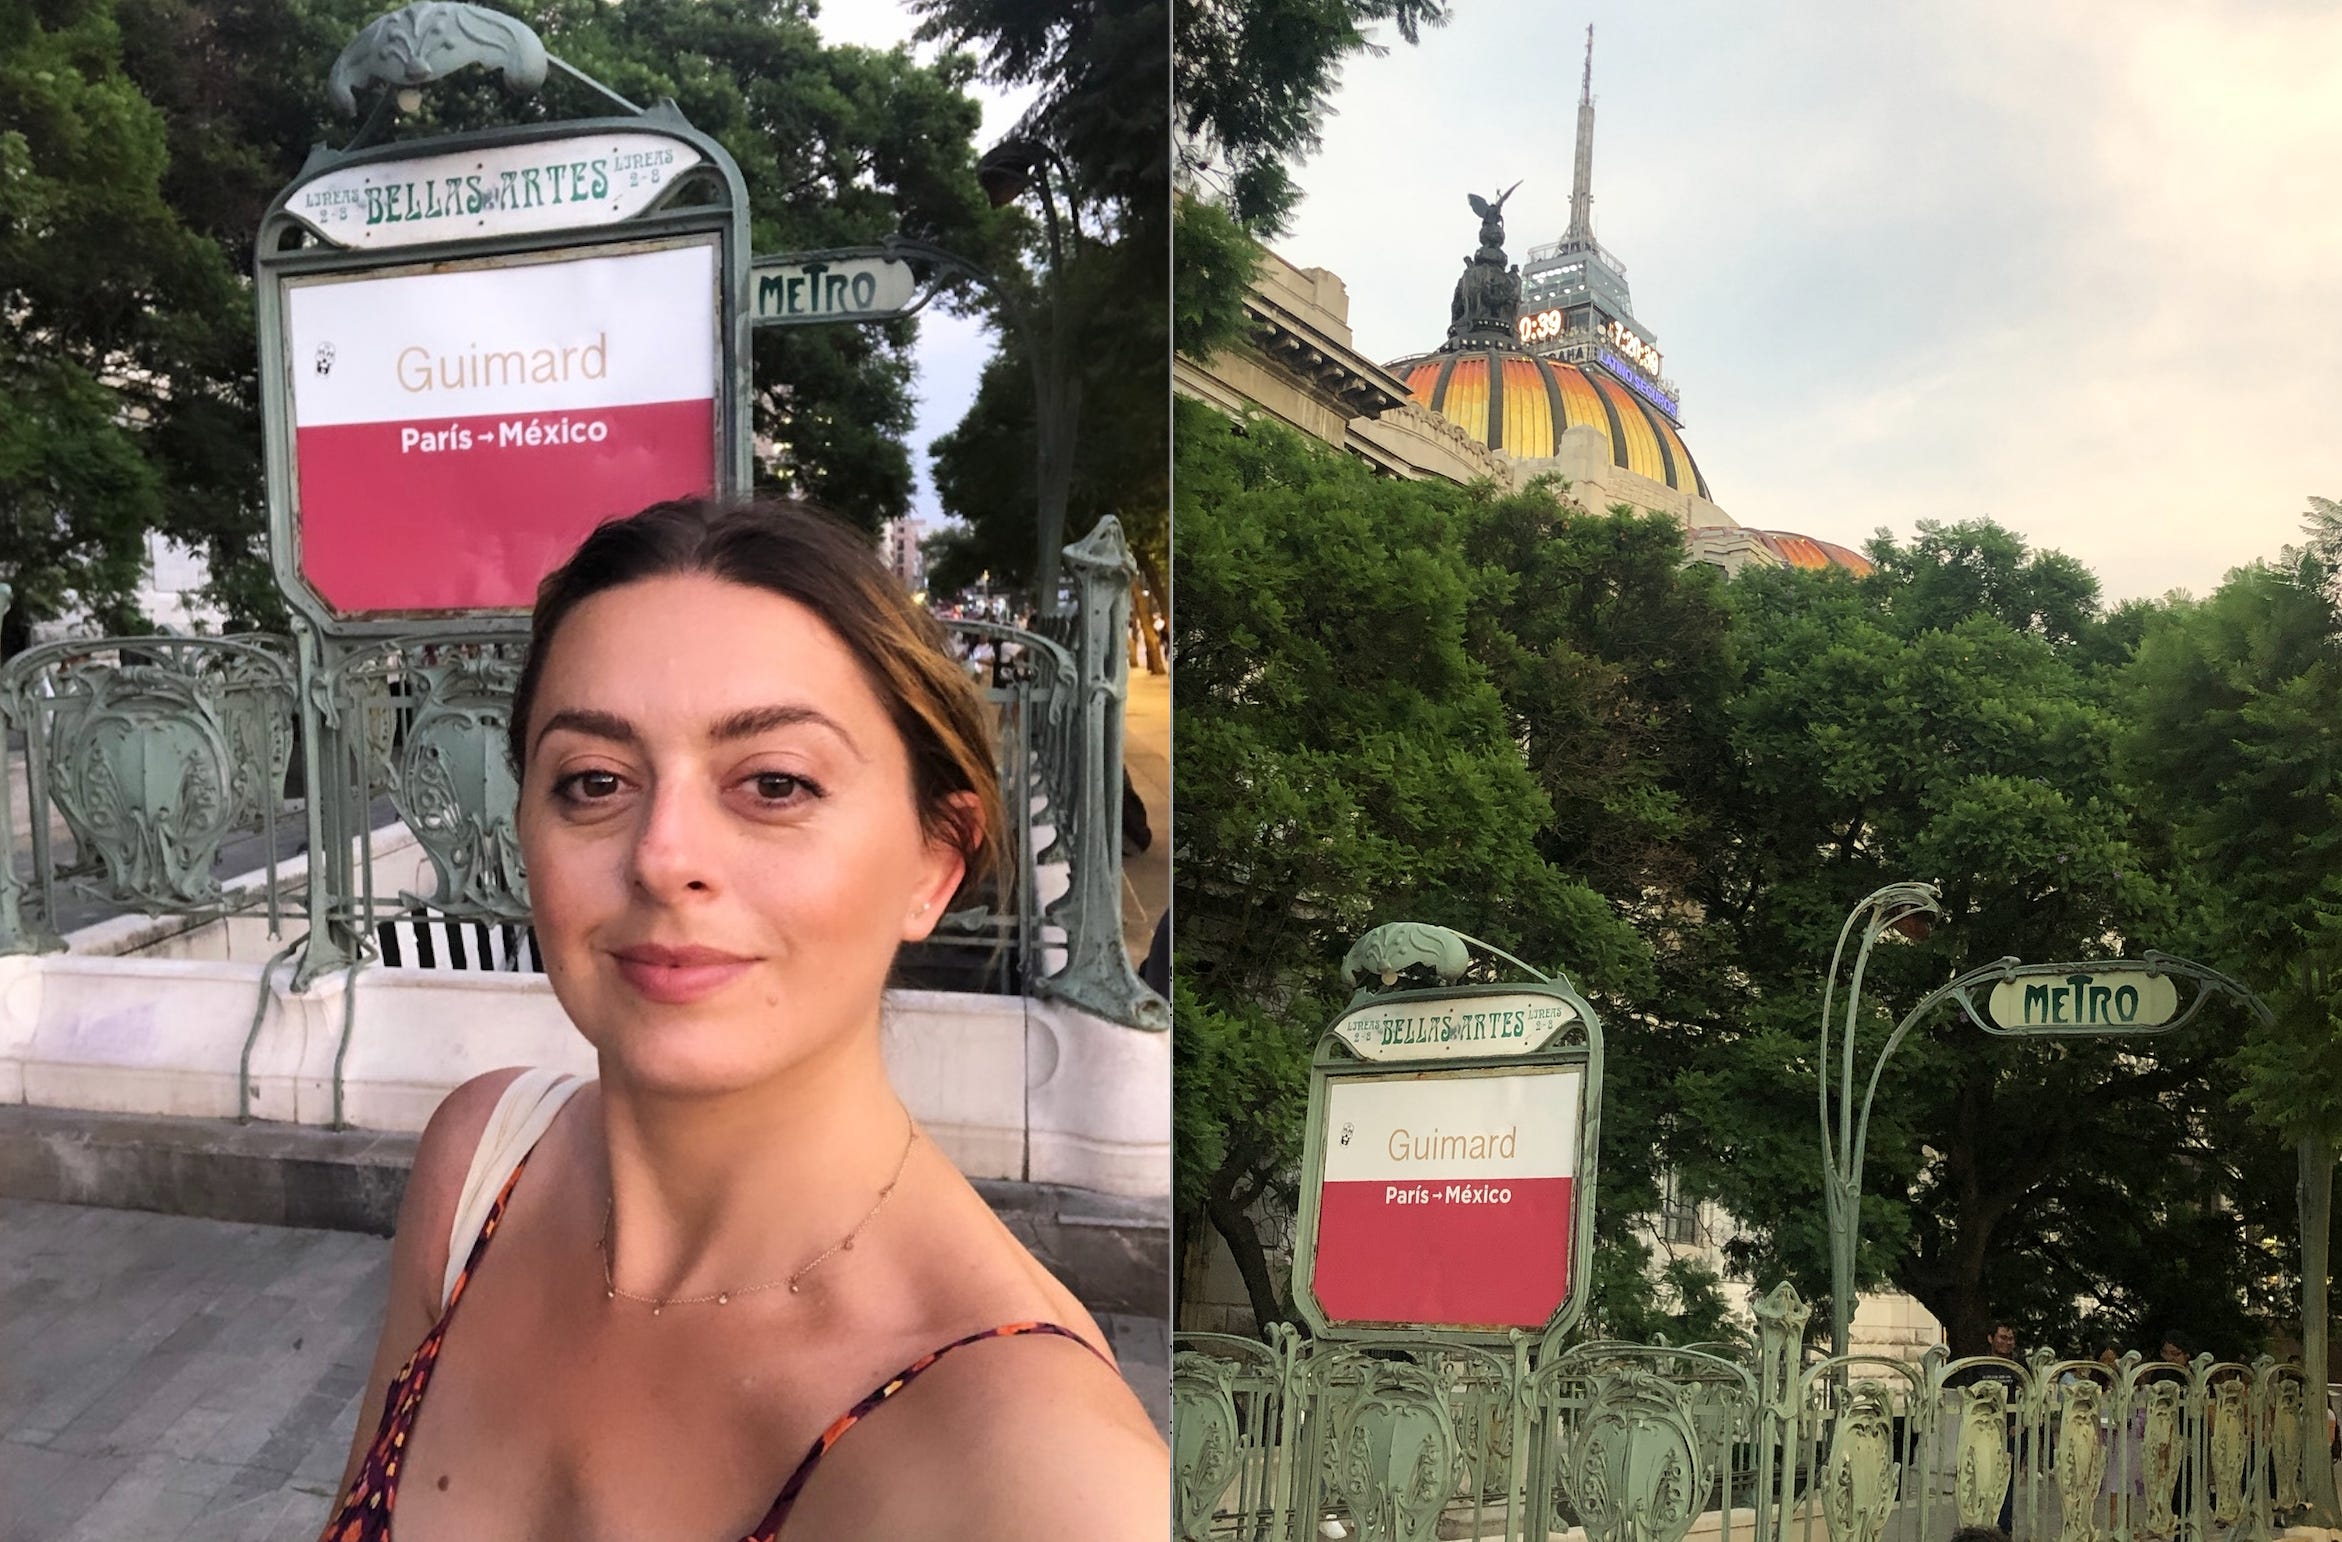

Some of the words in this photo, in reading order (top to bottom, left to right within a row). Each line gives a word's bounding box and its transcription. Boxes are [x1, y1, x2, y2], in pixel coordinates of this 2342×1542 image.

[364, 175, 483, 225] BELLAS
[500, 159, 608, 211] ARTES
[758, 263, 876, 316] METRO
[397, 332, 607, 393] Guimard
[1600, 350, 1633, 382] LATINO
[1634, 376, 1677, 418] SEGUROS
[401, 422, 473, 454] París
[499, 418, 608, 449] México
[2024, 974, 2139, 1025] METRO
[1381, 1016, 1451, 1045] BELLAS
[1459, 1011, 1525, 1042] ARTES
[1388, 1126, 1517, 1161] Guimard
[1385, 1185, 1429, 1204] París
[1445, 1184, 1512, 1204] México
